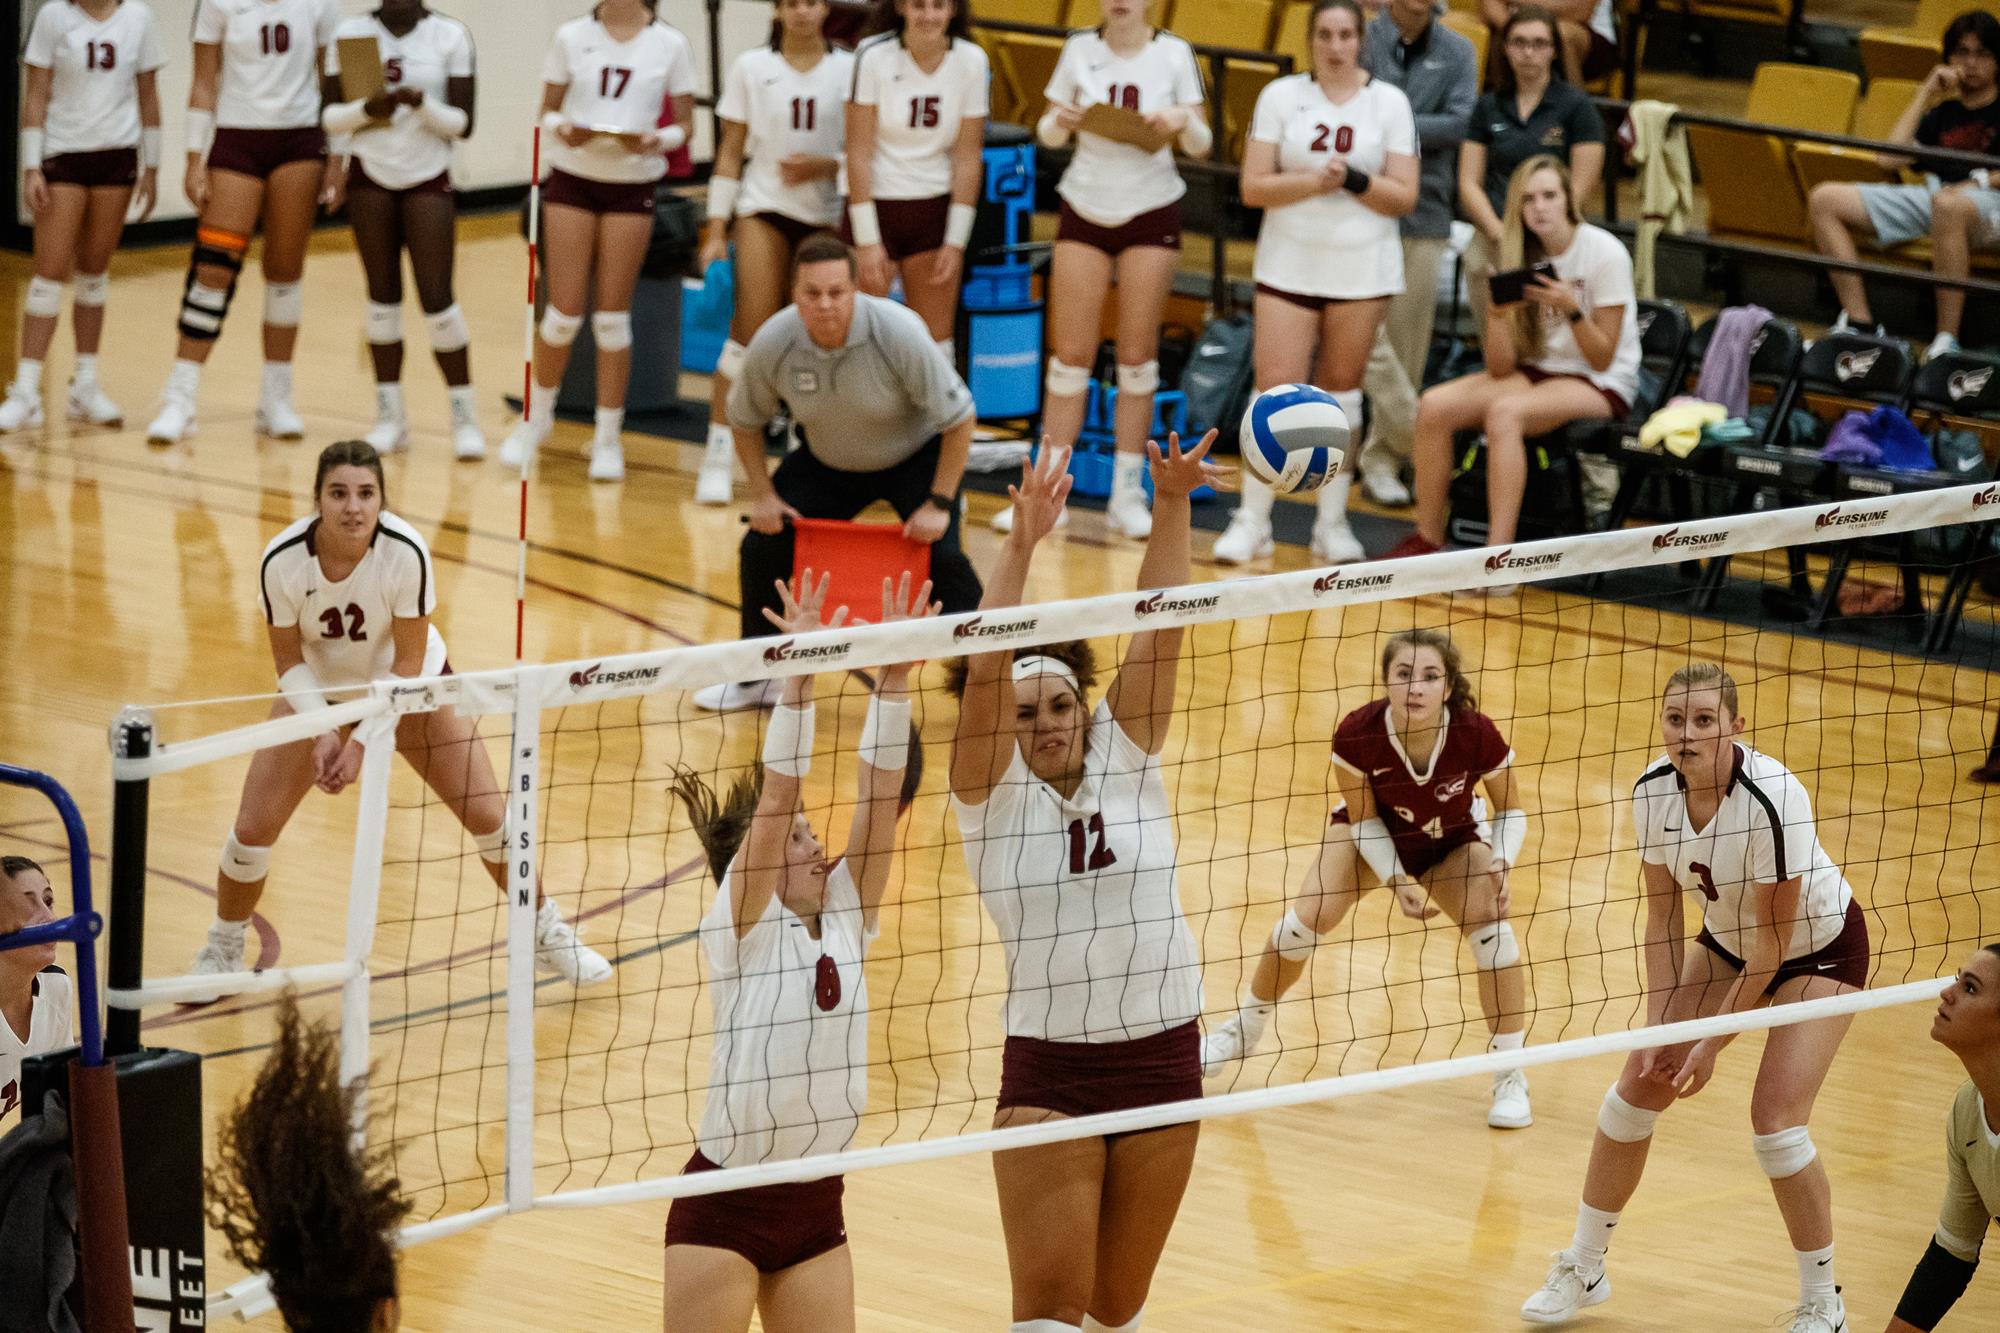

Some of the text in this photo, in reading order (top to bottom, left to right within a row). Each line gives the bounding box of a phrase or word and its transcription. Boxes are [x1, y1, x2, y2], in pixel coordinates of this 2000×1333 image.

[261, 24, 290, 55] 10
[86, 40, 116, 70] 13
[601, 66, 632, 98] 17
[792, 97, 815, 130] 11
[910, 96, 940, 128] 15
[1311, 123, 1353, 153] 20
[1836, 510, 1889, 525] ERSKINE
[1674, 531, 1729, 547] ERSKINE
[1507, 552, 1564, 568] ERSKINE
[1336, 573, 1394, 590] ERSKINE
[1160, 596, 1220, 612] ERSKINE
[319, 602, 367, 641] 32
[978, 619, 1038, 636] ERSKINE
[790, 642, 852, 660] ERSKINE
[596, 667, 662, 684] ERSKINE
[518, 774, 530, 906] BISON
[1068, 811, 1117, 874] 12
[1689, 861, 1719, 902] 3
